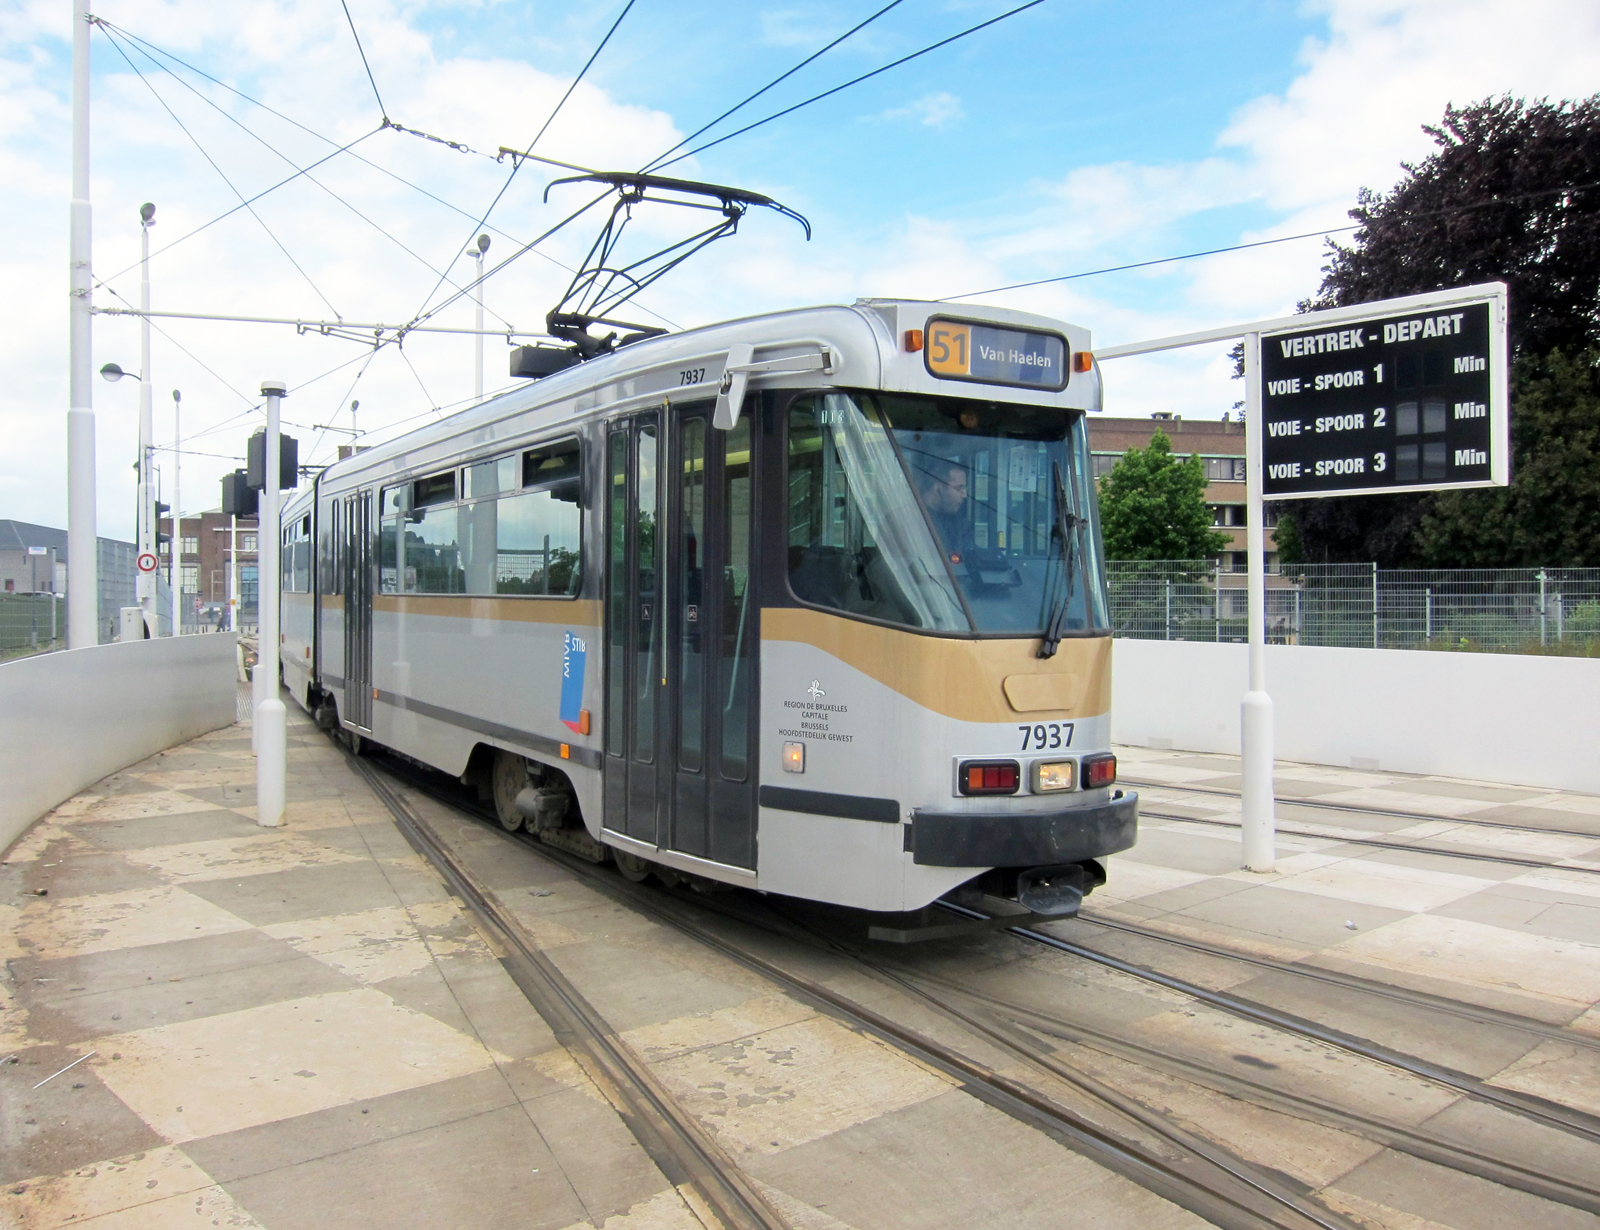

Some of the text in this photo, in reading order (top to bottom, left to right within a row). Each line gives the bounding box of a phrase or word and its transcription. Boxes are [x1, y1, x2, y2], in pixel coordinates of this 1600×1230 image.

[932, 330, 1051, 368] 51 Van Haelen
[1280, 328, 1364, 359] VERTREK
[1383, 313, 1464, 344] DEPART
[680, 368, 705, 386] 7937
[1267, 377, 1300, 396] VOIE
[1314, 370, 1364, 391] SPOOR
[1373, 363, 1384, 384] 1
[1453, 355, 1486, 374] Min
[1268, 419, 1301, 438] VOIE
[1315, 413, 1365, 433] SPOOR
[1373, 407, 1386, 428] 2
[1454, 402, 1486, 420] Min
[1268, 463, 1301, 480] VOIE
[1315, 457, 1365, 477] SPOOR
[1373, 452, 1386, 472] 3
[1454, 449, 1486, 466] Min
[783, 700, 848, 713] REGION DE BRUXELLES
[801, 711, 828, 721] CAPITALE
[778, 728, 853, 743] HOOFDSTEDELIJK GEWEST
[801, 721, 829, 731] BRUSSELS
[1018, 723, 1074, 751] 7937
